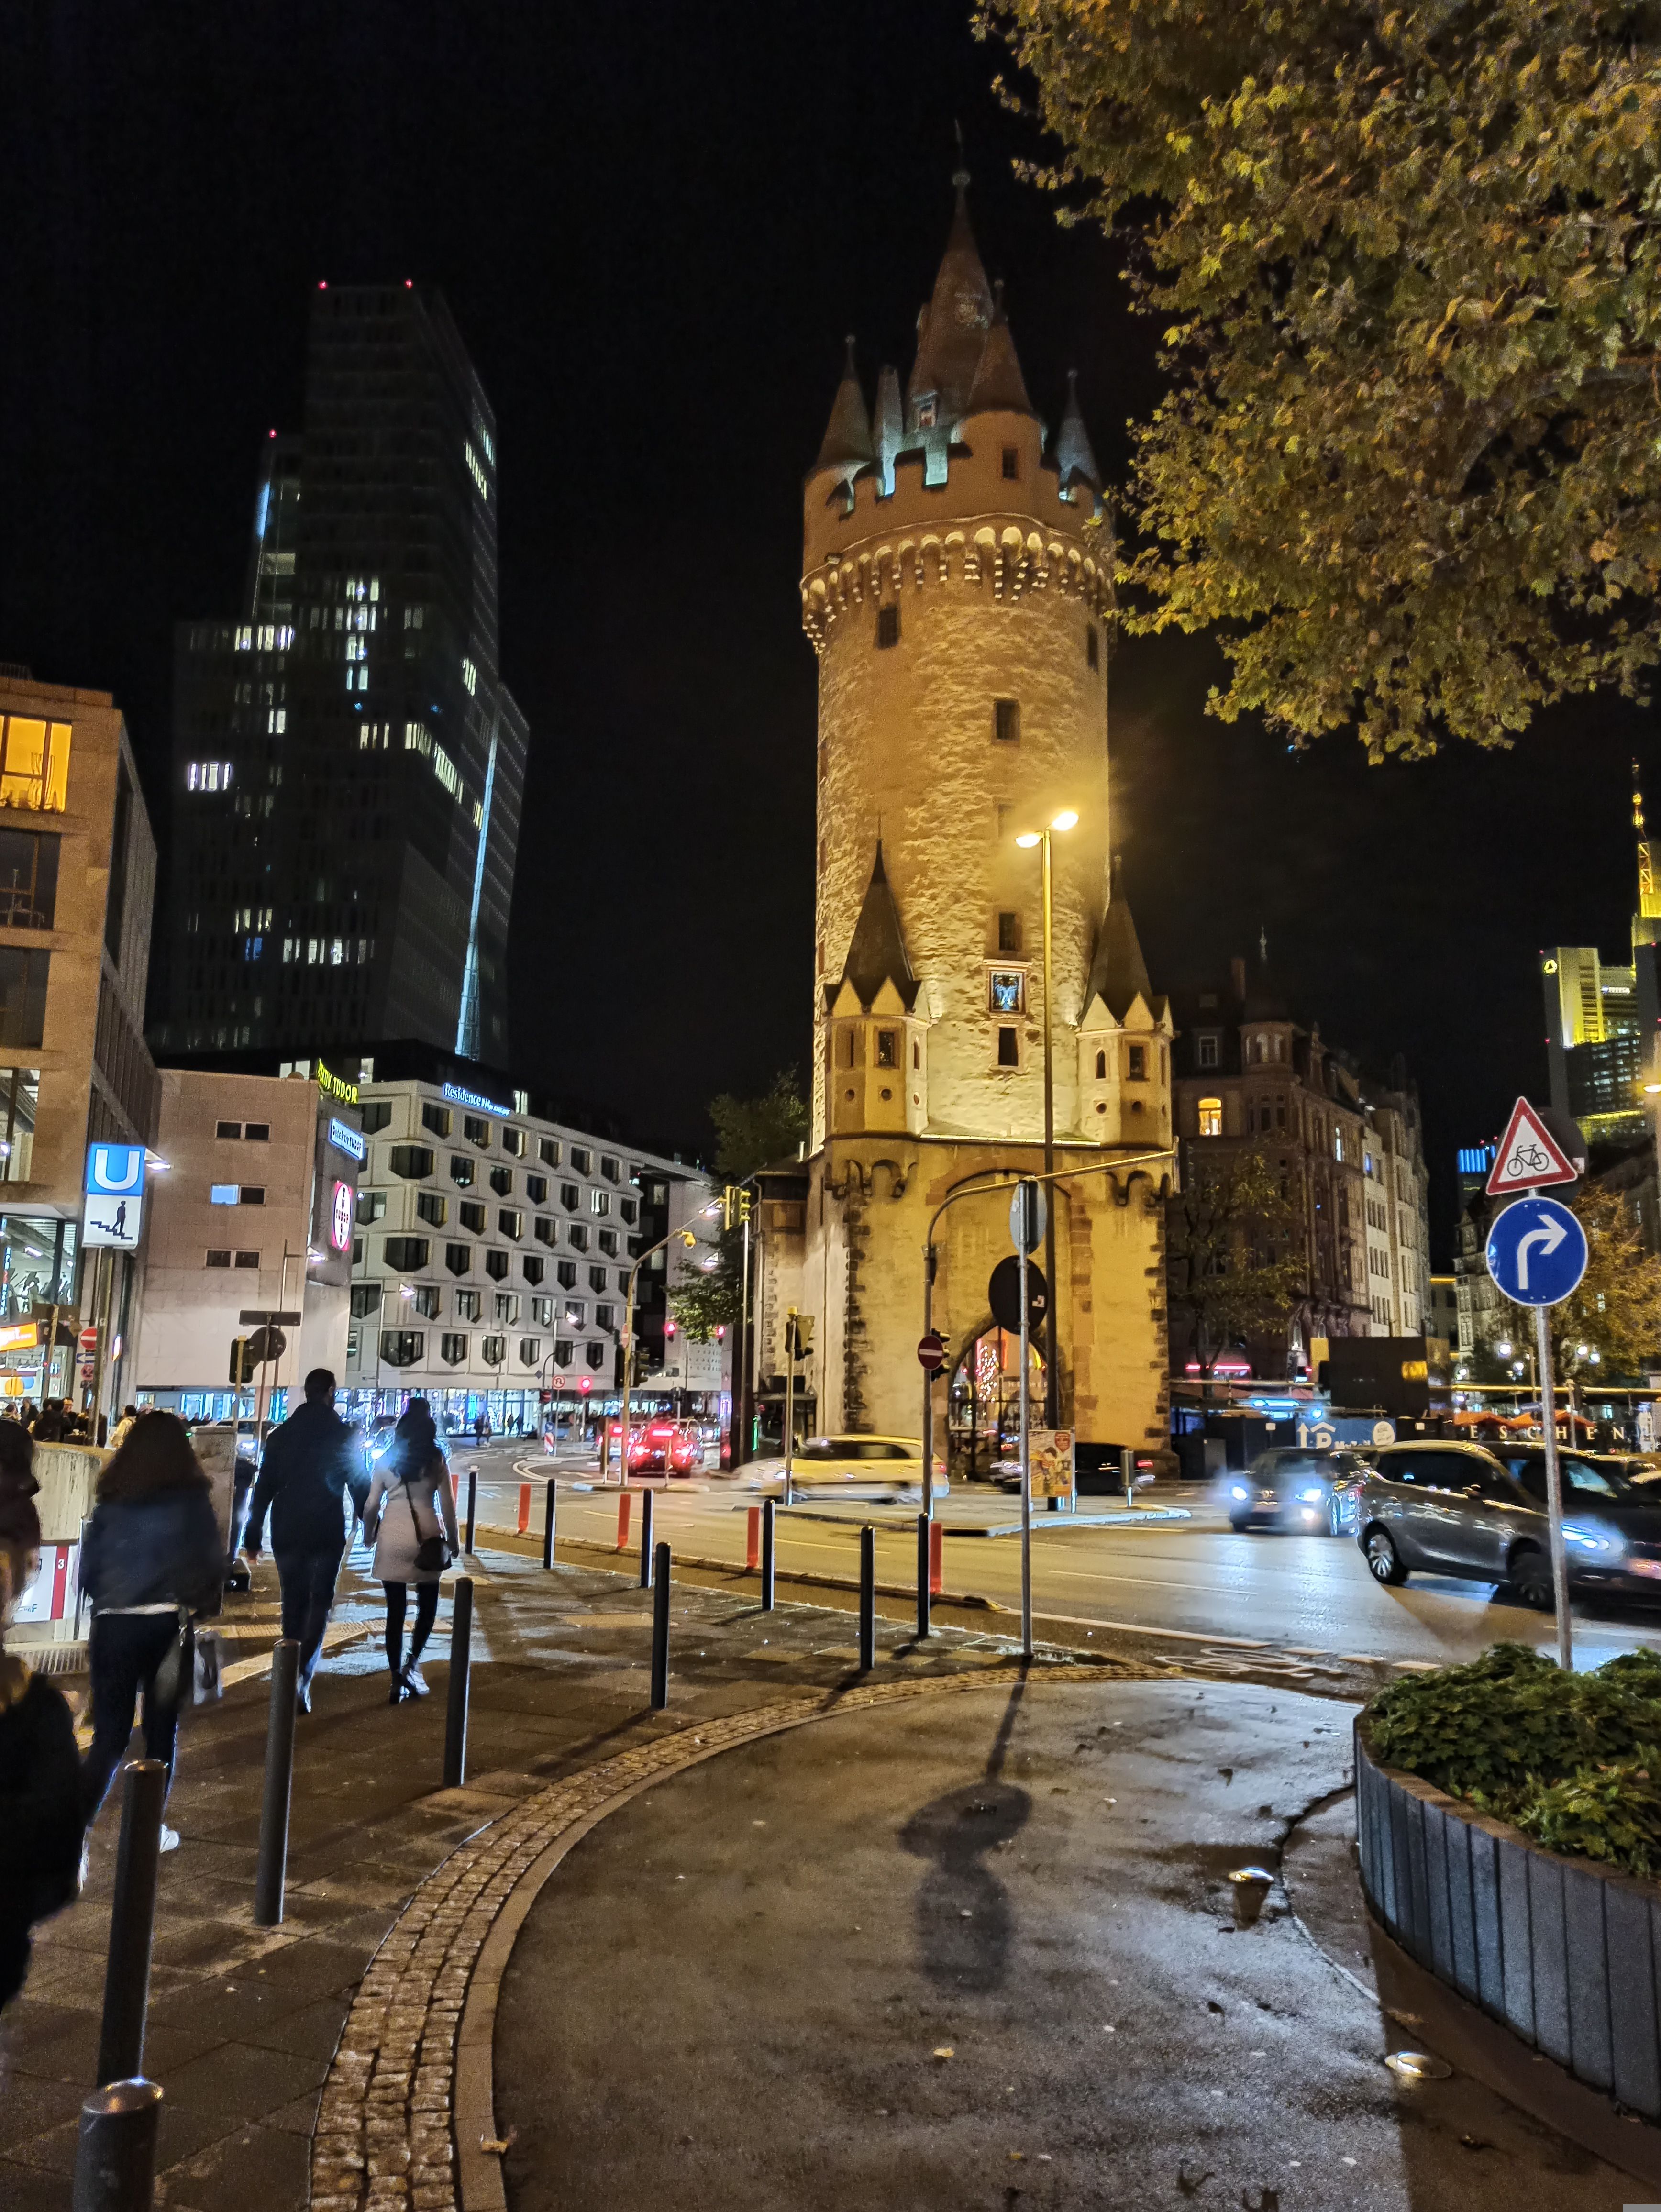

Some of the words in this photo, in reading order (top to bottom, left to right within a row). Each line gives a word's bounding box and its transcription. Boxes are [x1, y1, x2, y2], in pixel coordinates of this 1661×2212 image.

[333, 1076, 358, 1104] TUDOR
[445, 1083, 481, 1107] Residence
[94, 1149, 140, 1190] U
[58, 1558, 65, 1570] 3
